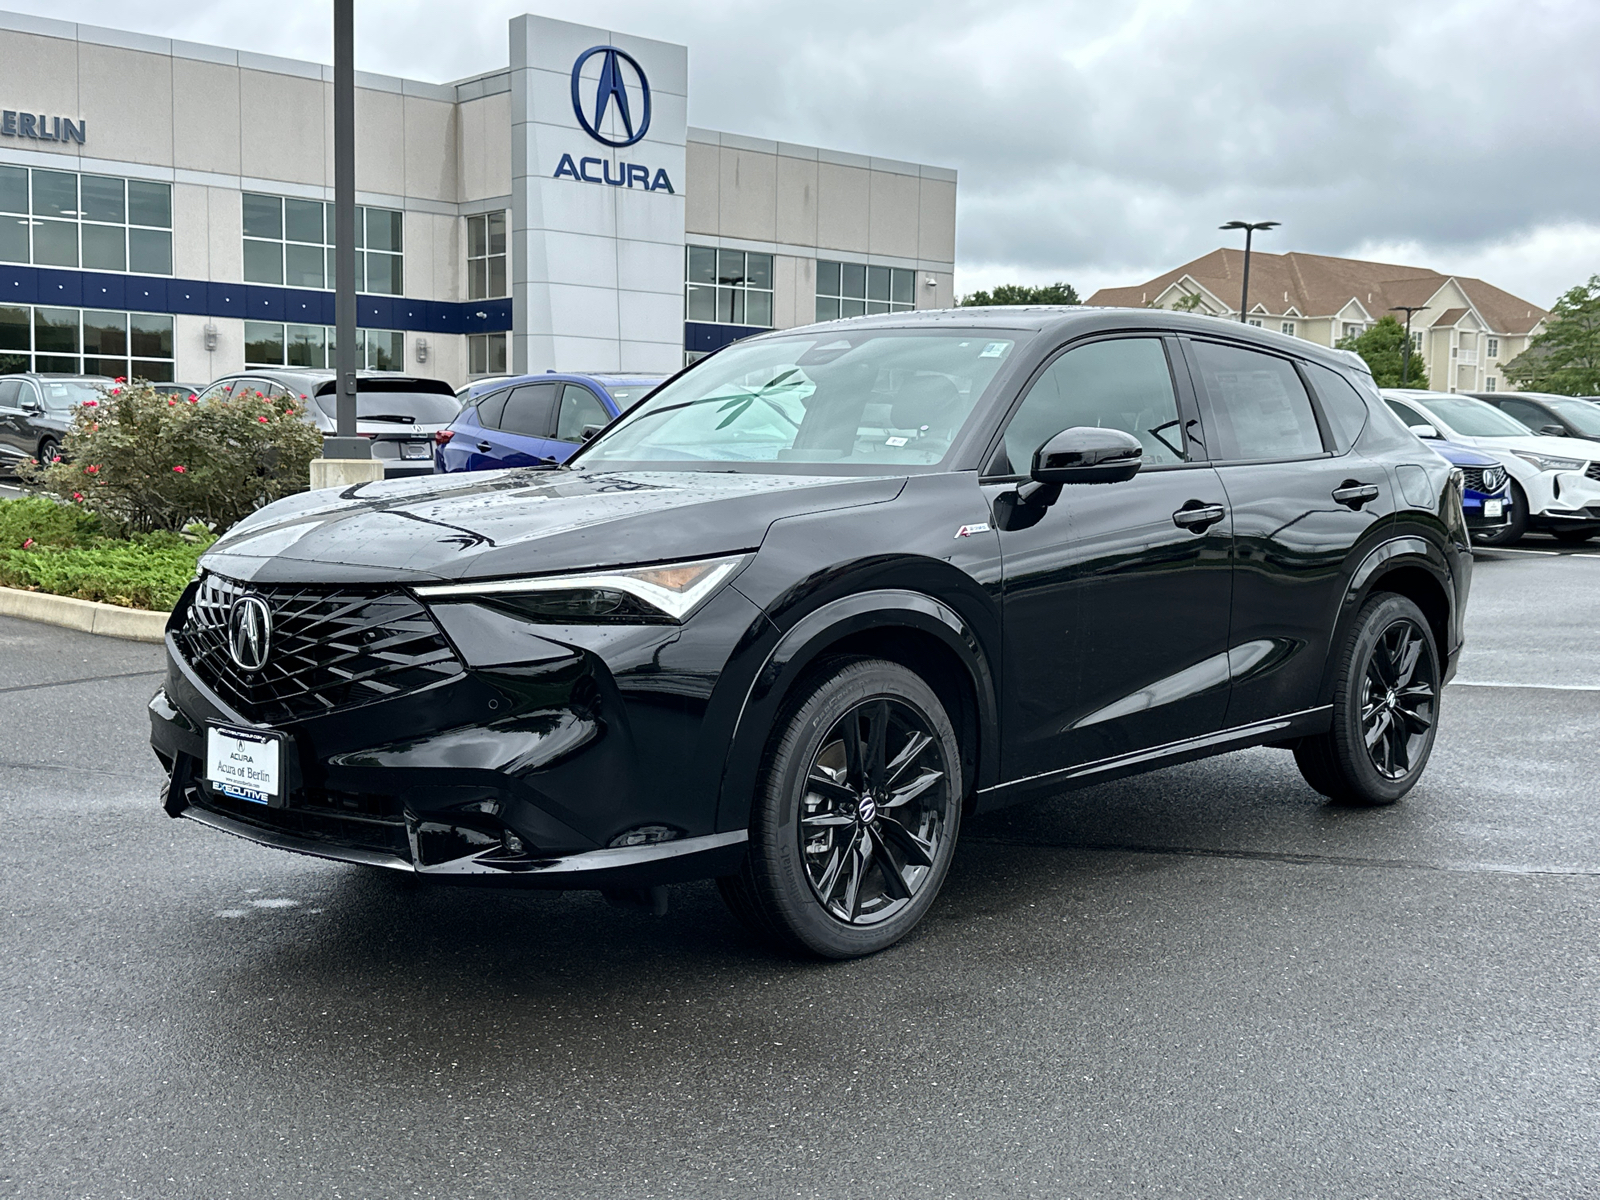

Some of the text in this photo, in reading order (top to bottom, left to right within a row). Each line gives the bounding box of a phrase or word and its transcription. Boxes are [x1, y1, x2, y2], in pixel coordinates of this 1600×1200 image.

[0, 110, 86, 144] ERLIN
[553, 153, 675, 194] ACURA
[230, 752, 254, 763] ACURA
[217, 760, 270, 782] Acura of Berlin
[212, 781, 268, 801] EXECUTIVE
